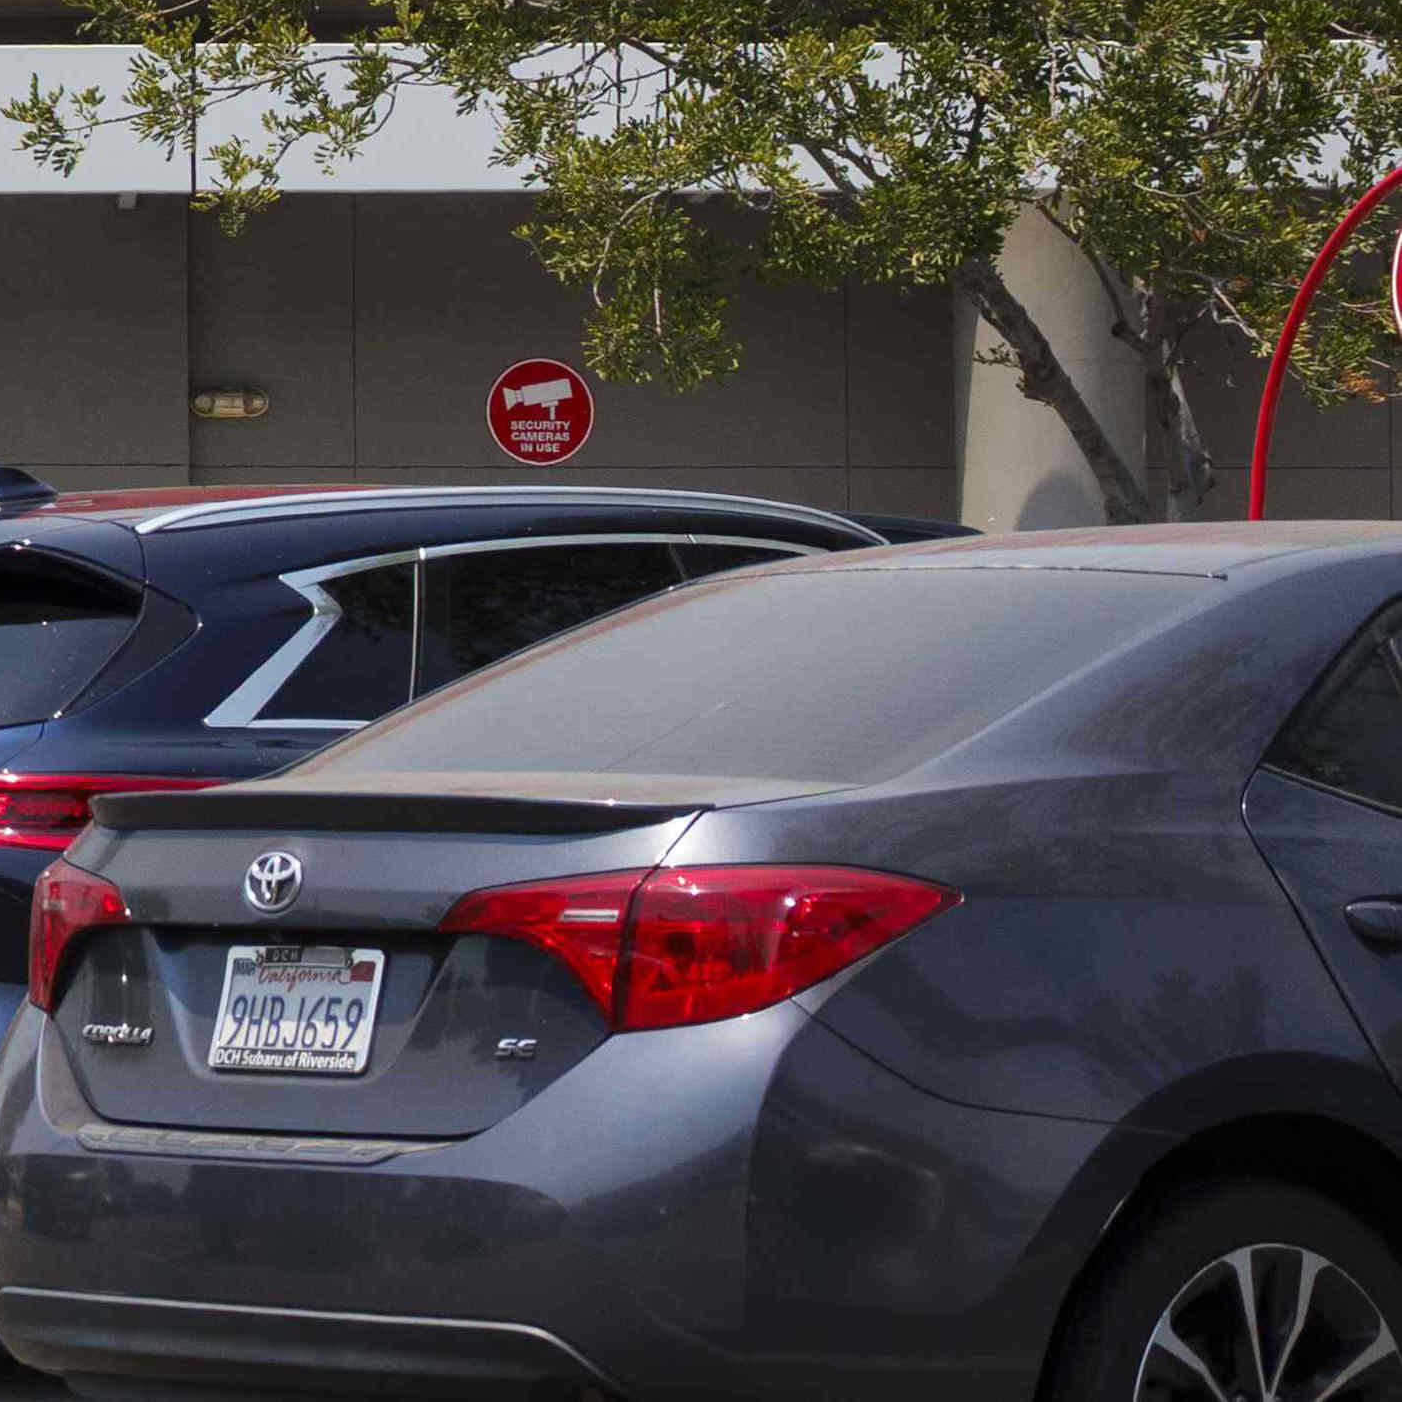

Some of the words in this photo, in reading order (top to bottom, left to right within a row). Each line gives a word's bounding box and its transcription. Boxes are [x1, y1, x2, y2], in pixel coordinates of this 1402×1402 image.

[510, 420, 571, 430] SECURITY
[510, 431, 571, 442] CAMERAS
[521, 443, 533, 452] IN
[536, 443, 560, 452] USE
[258, 965, 351, 993] California
[227, 995, 364, 1049] 9HBJ659
[493, 1038, 537, 1056] SE
[216, 1049, 241, 1064] DCH
[241, 1050, 284, 1066] Subaru
[284, 1052, 298, 1067] of
[299, 1052, 355, 1069] Riverside
